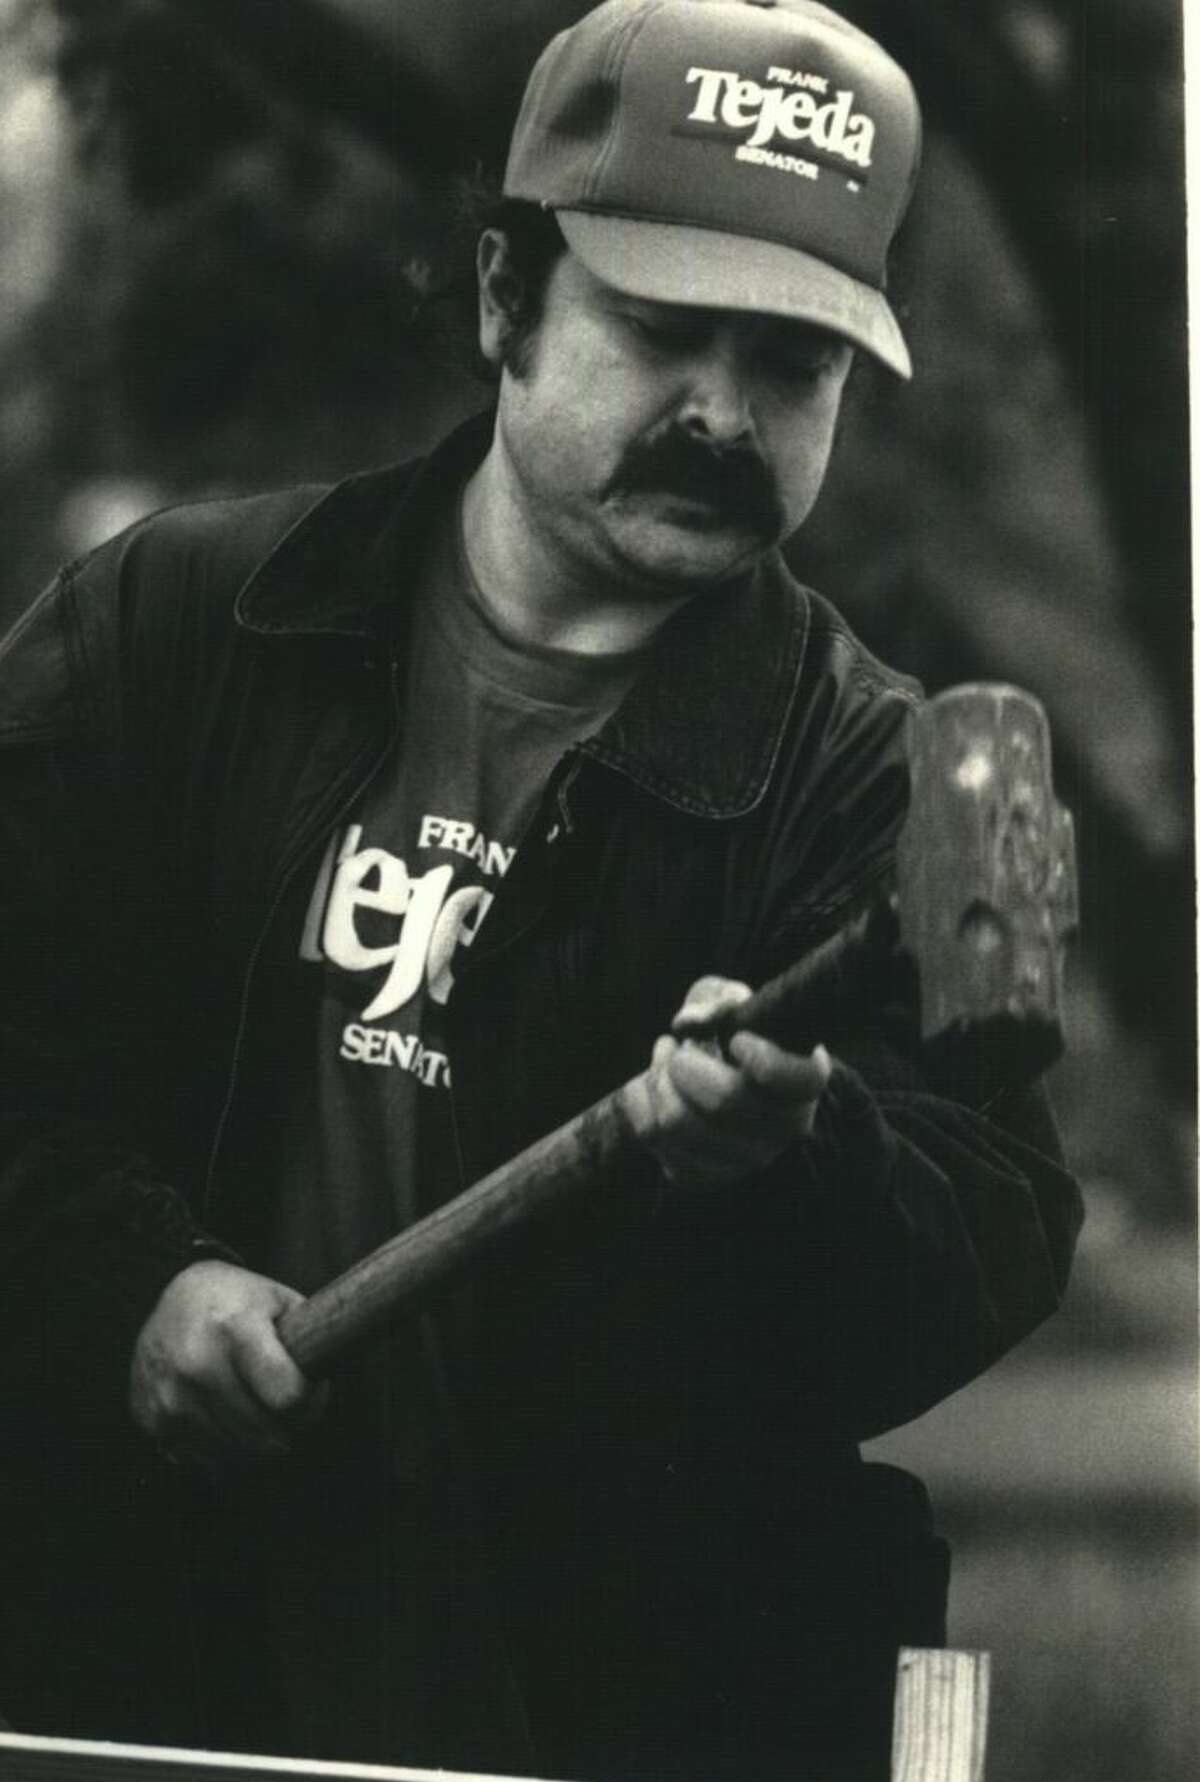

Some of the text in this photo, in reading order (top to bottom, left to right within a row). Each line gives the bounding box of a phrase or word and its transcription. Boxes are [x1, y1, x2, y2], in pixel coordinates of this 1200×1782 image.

[766, 65, 829, 94] FRANK
[684, 66, 876, 168] Tejeda
[734, 144, 819, 181] SENATOR
